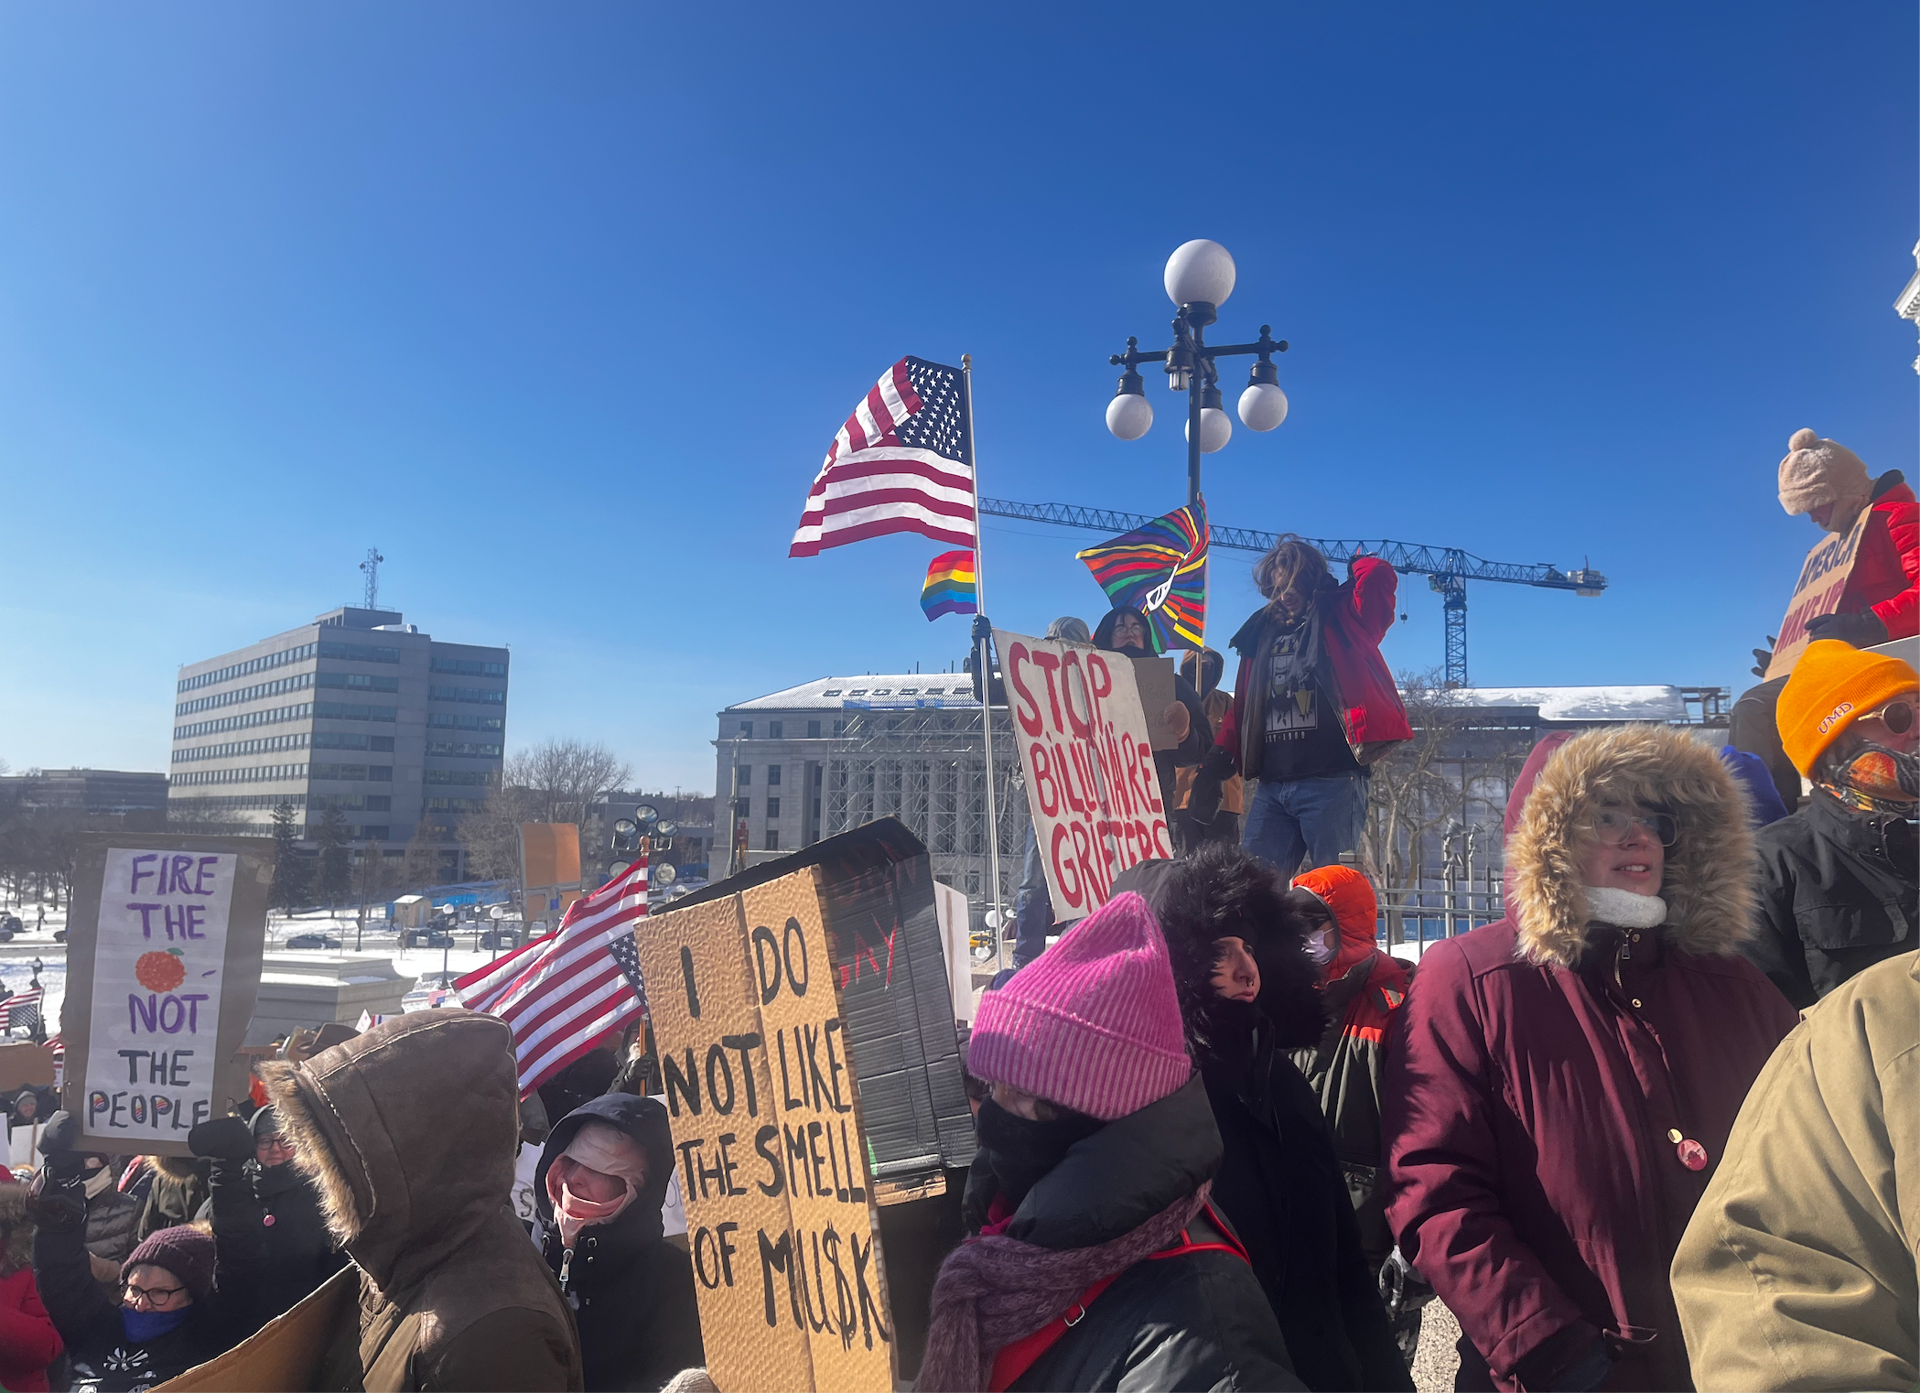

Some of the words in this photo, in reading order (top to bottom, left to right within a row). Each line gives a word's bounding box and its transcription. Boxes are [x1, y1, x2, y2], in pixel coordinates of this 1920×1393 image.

[1794, 523, 1861, 597] AMERICA
[1773, 594, 1822, 657] WAKE
[1820, 577, 1845, 615] UP
[1009, 641, 1112, 739] STOP
[1817, 702, 1854, 735] UMD
[131, 854, 218, 896] FIRE
[127, 904, 207, 941] THE
[681, 946, 701, 1020] I
[752, 916, 808, 1006] DO
[128, 993, 209, 1034] NOT
[117, 1050, 194, 1086] THE
[663, 1032, 761, 1118] NOT
[777, 1018, 853, 1113] LIKE
[89, 1091, 209, 1129] PEOPLE
[677, 1133, 747, 1202] THE
[755, 1119, 867, 1203] SMELL
[694, 1221, 738, 1290] OF
[757, 1219, 891, 1353] MU$K
